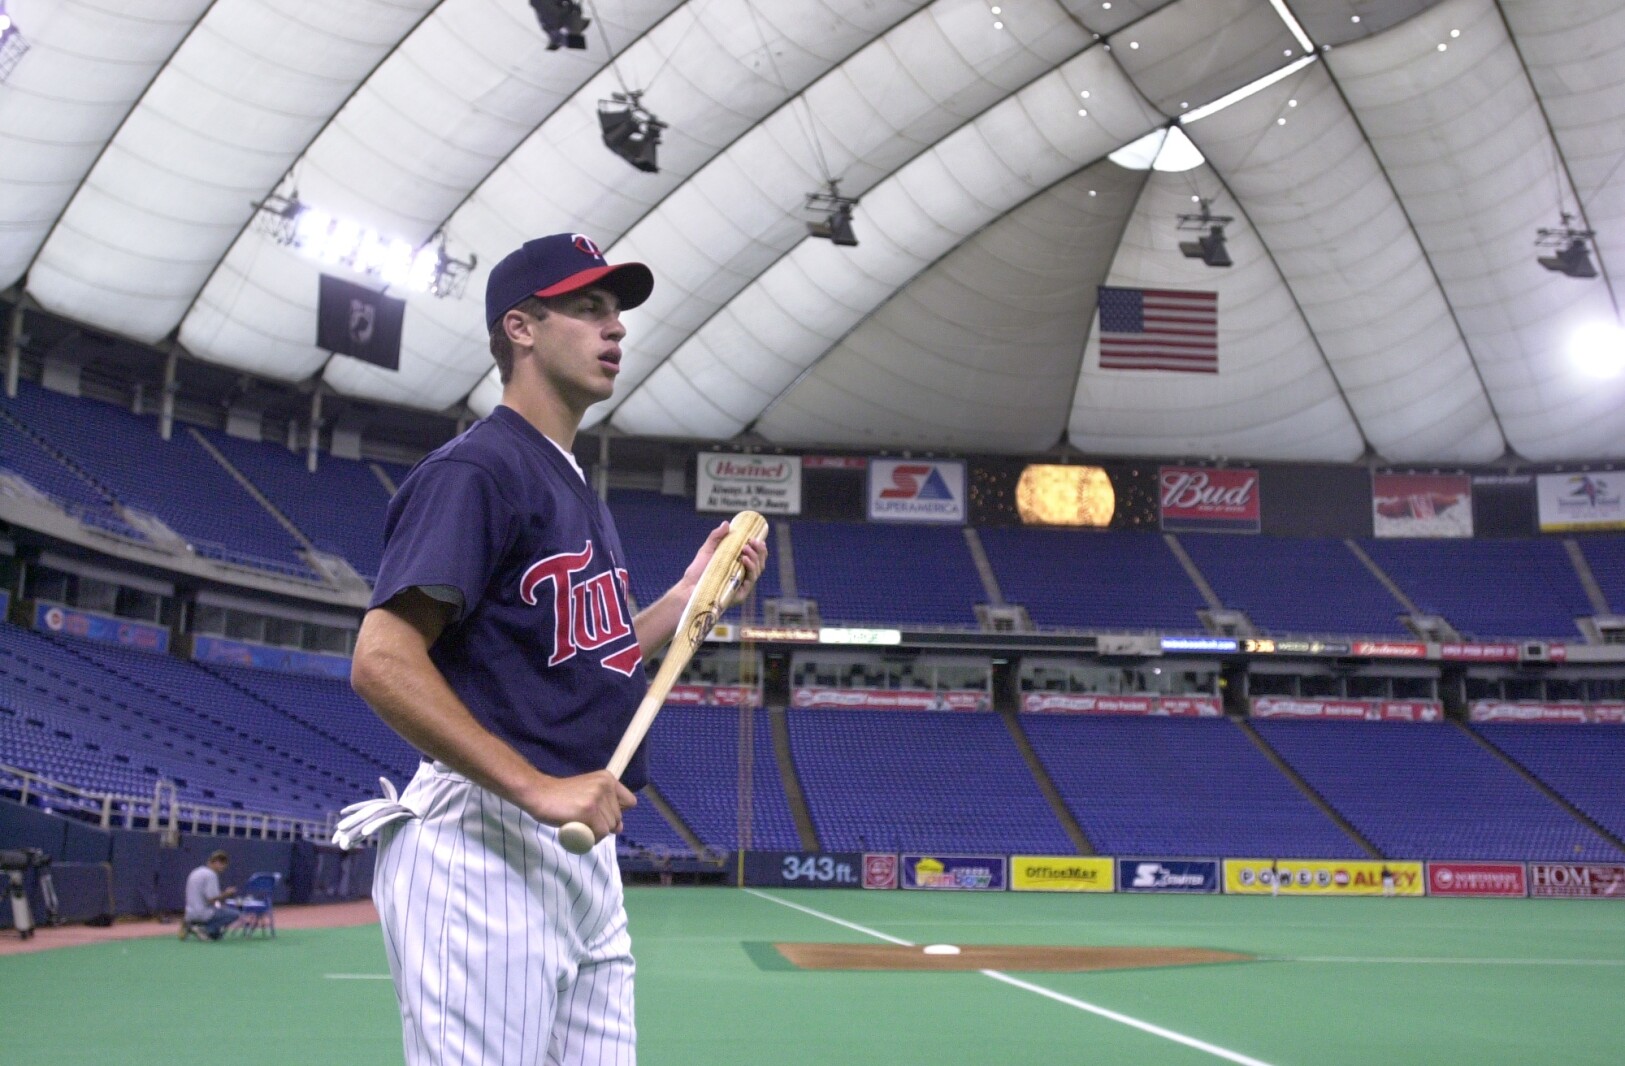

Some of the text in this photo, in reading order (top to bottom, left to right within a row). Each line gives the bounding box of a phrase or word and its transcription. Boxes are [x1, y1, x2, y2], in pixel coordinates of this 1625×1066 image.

[715, 461, 784, 477] Hormel
[1161, 471, 1255, 508] Bud
[874, 502, 960, 513] SUPERAMERICA
[1025, 866, 1098, 880] OfficeMax
[1353, 870, 1416, 887] ALEY
[1532, 865, 1590, 887] HOM
